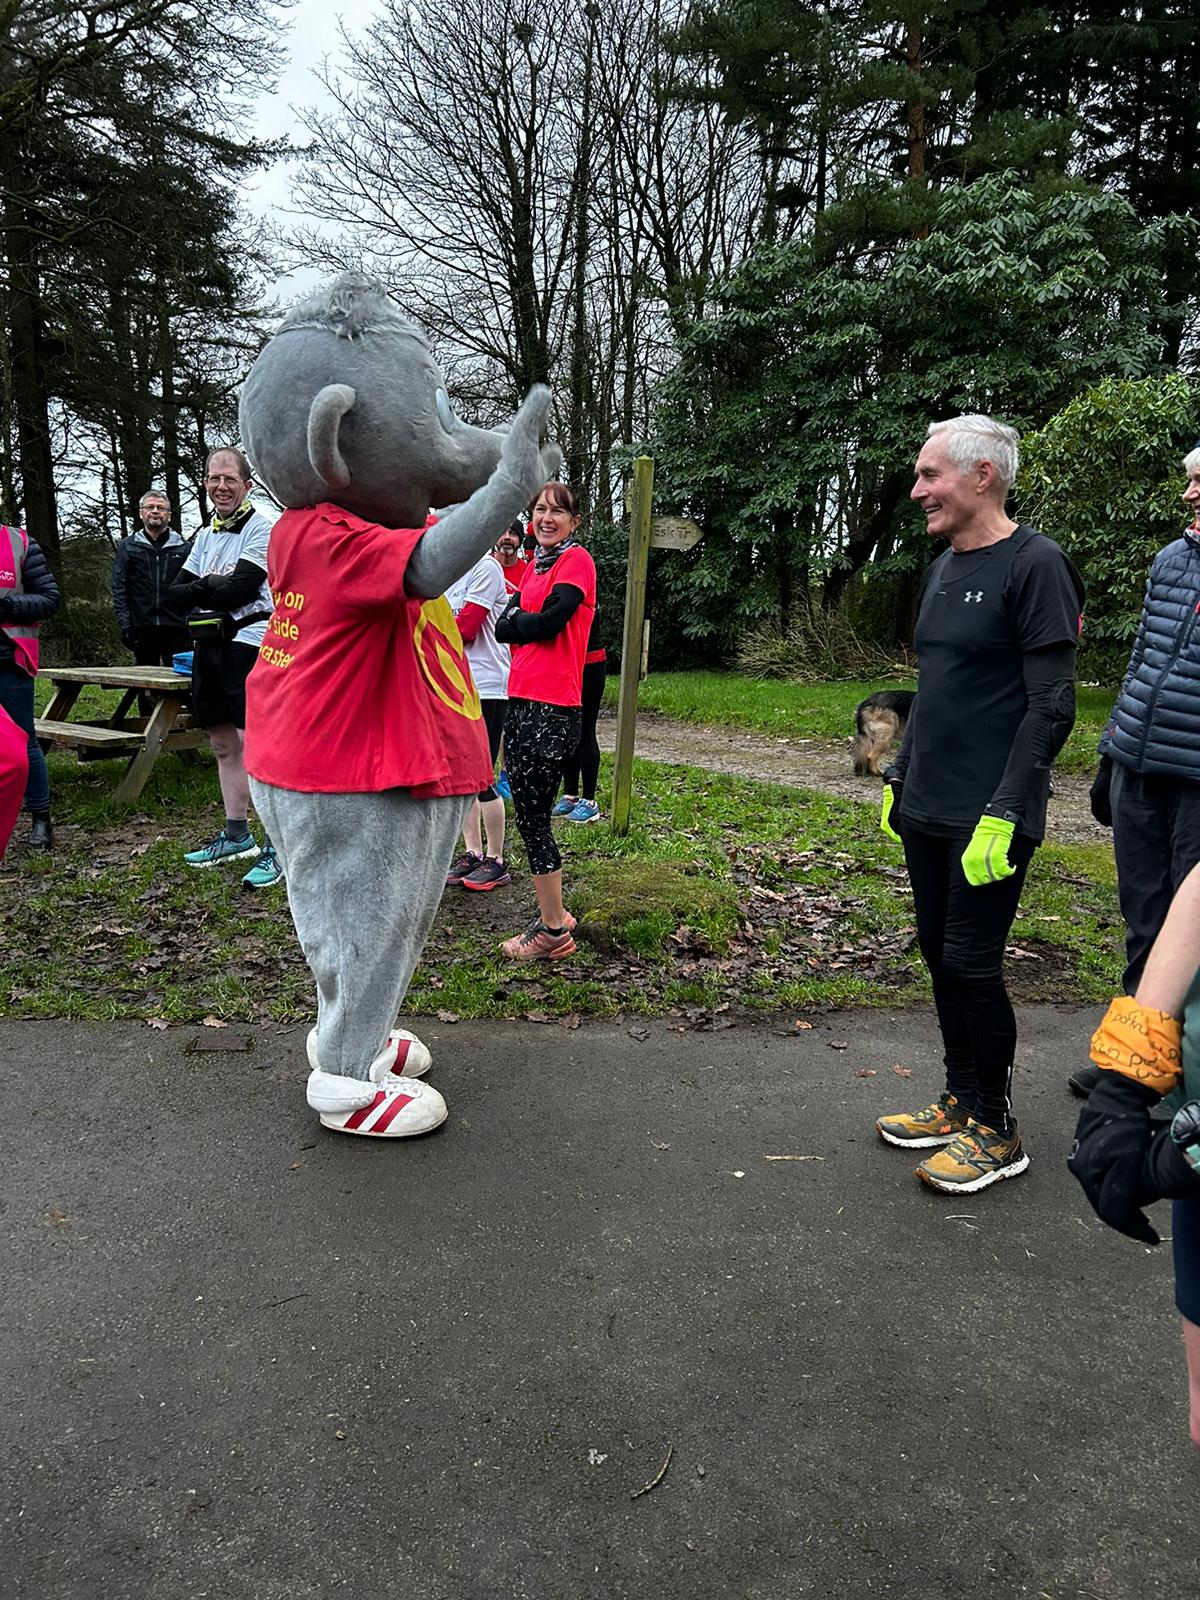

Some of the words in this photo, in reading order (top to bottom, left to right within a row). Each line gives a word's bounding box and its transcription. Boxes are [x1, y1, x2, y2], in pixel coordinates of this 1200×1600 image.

[284, 591, 305, 610] on
[273, 617, 299, 641] side
[260, 645, 295, 669] caster
